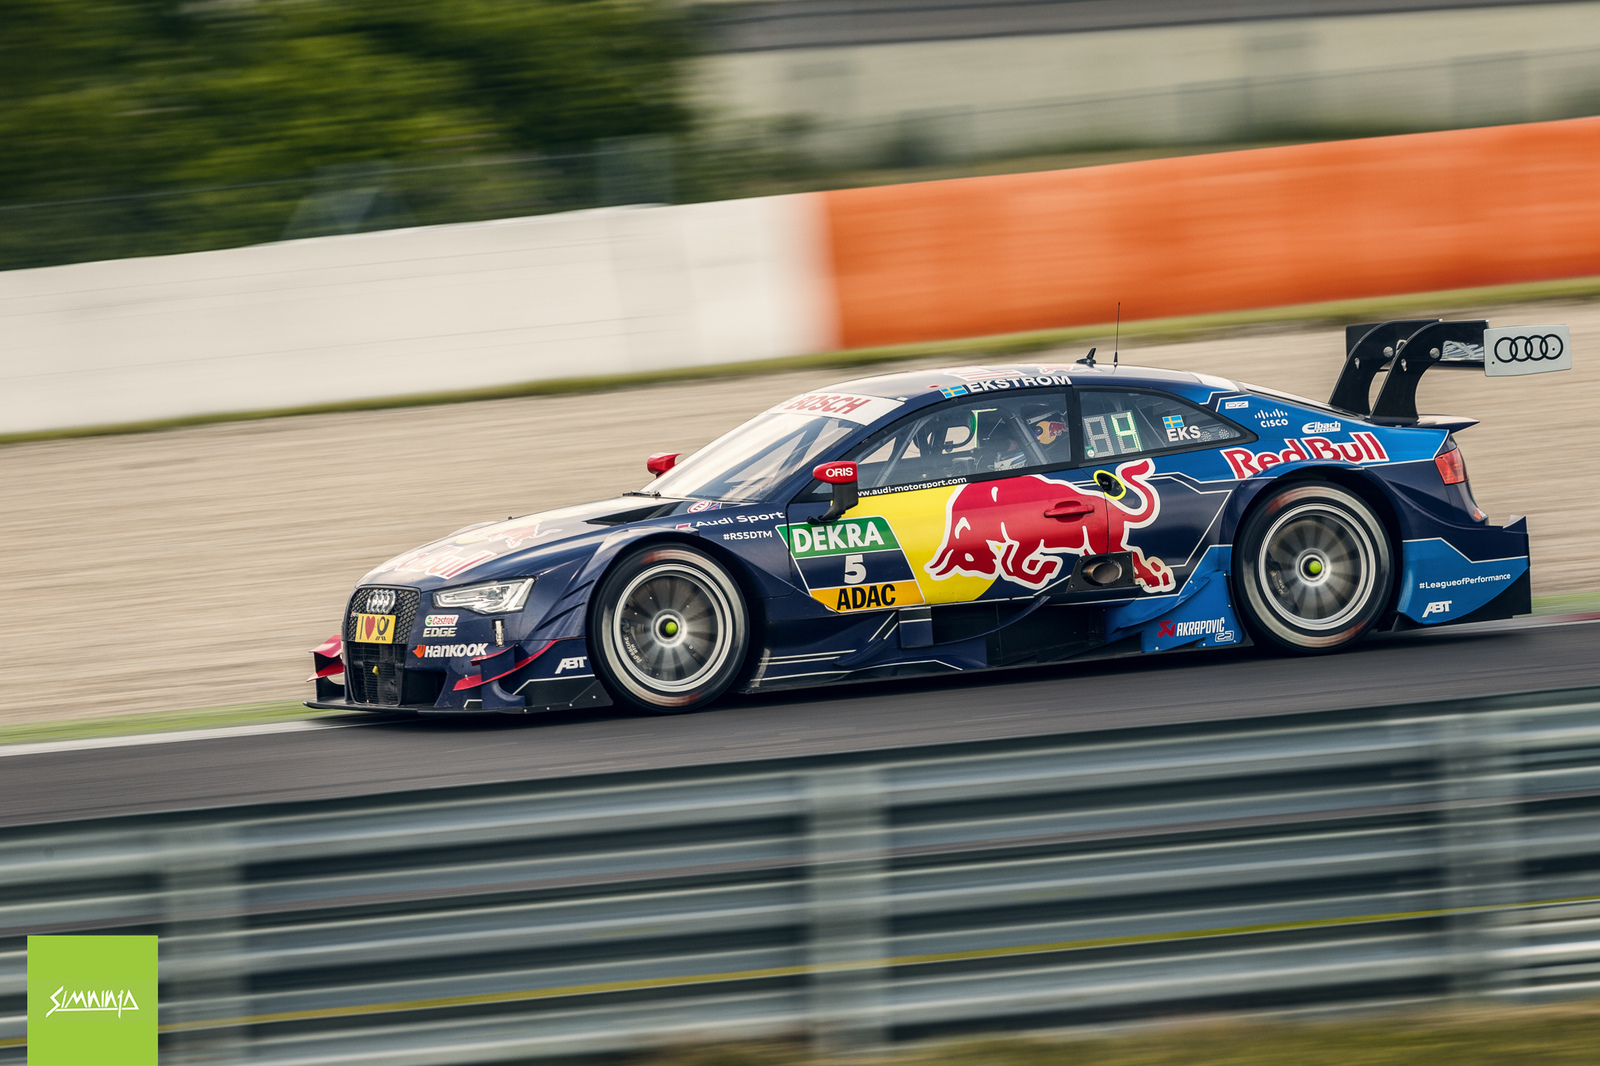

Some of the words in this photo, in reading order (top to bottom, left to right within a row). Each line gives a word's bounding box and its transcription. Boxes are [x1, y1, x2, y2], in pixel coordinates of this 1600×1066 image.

[784, 395, 872, 414] BOSCH
[1166, 425, 1201, 442] EKS
[1223, 439, 1308, 480] Red
[1303, 433, 1389, 463] Bull
[825, 467, 854, 478] ORIS
[695, 517, 734, 527] Audi
[736, 511, 785, 523] Sport
[723, 530, 773, 541] #RS5DTM
[791, 521, 885, 553] DEKRA
[844, 554, 867, 585] 5
[1419, 573, 1511, 589] #LeagueofPerformance
[836, 584, 896, 611] ADAC
[1421, 600, 1453, 618] ABT
[431, 615, 456, 626] Castrol
[422, 627, 458, 638] EDGE
[554, 656, 587, 674] ABT
